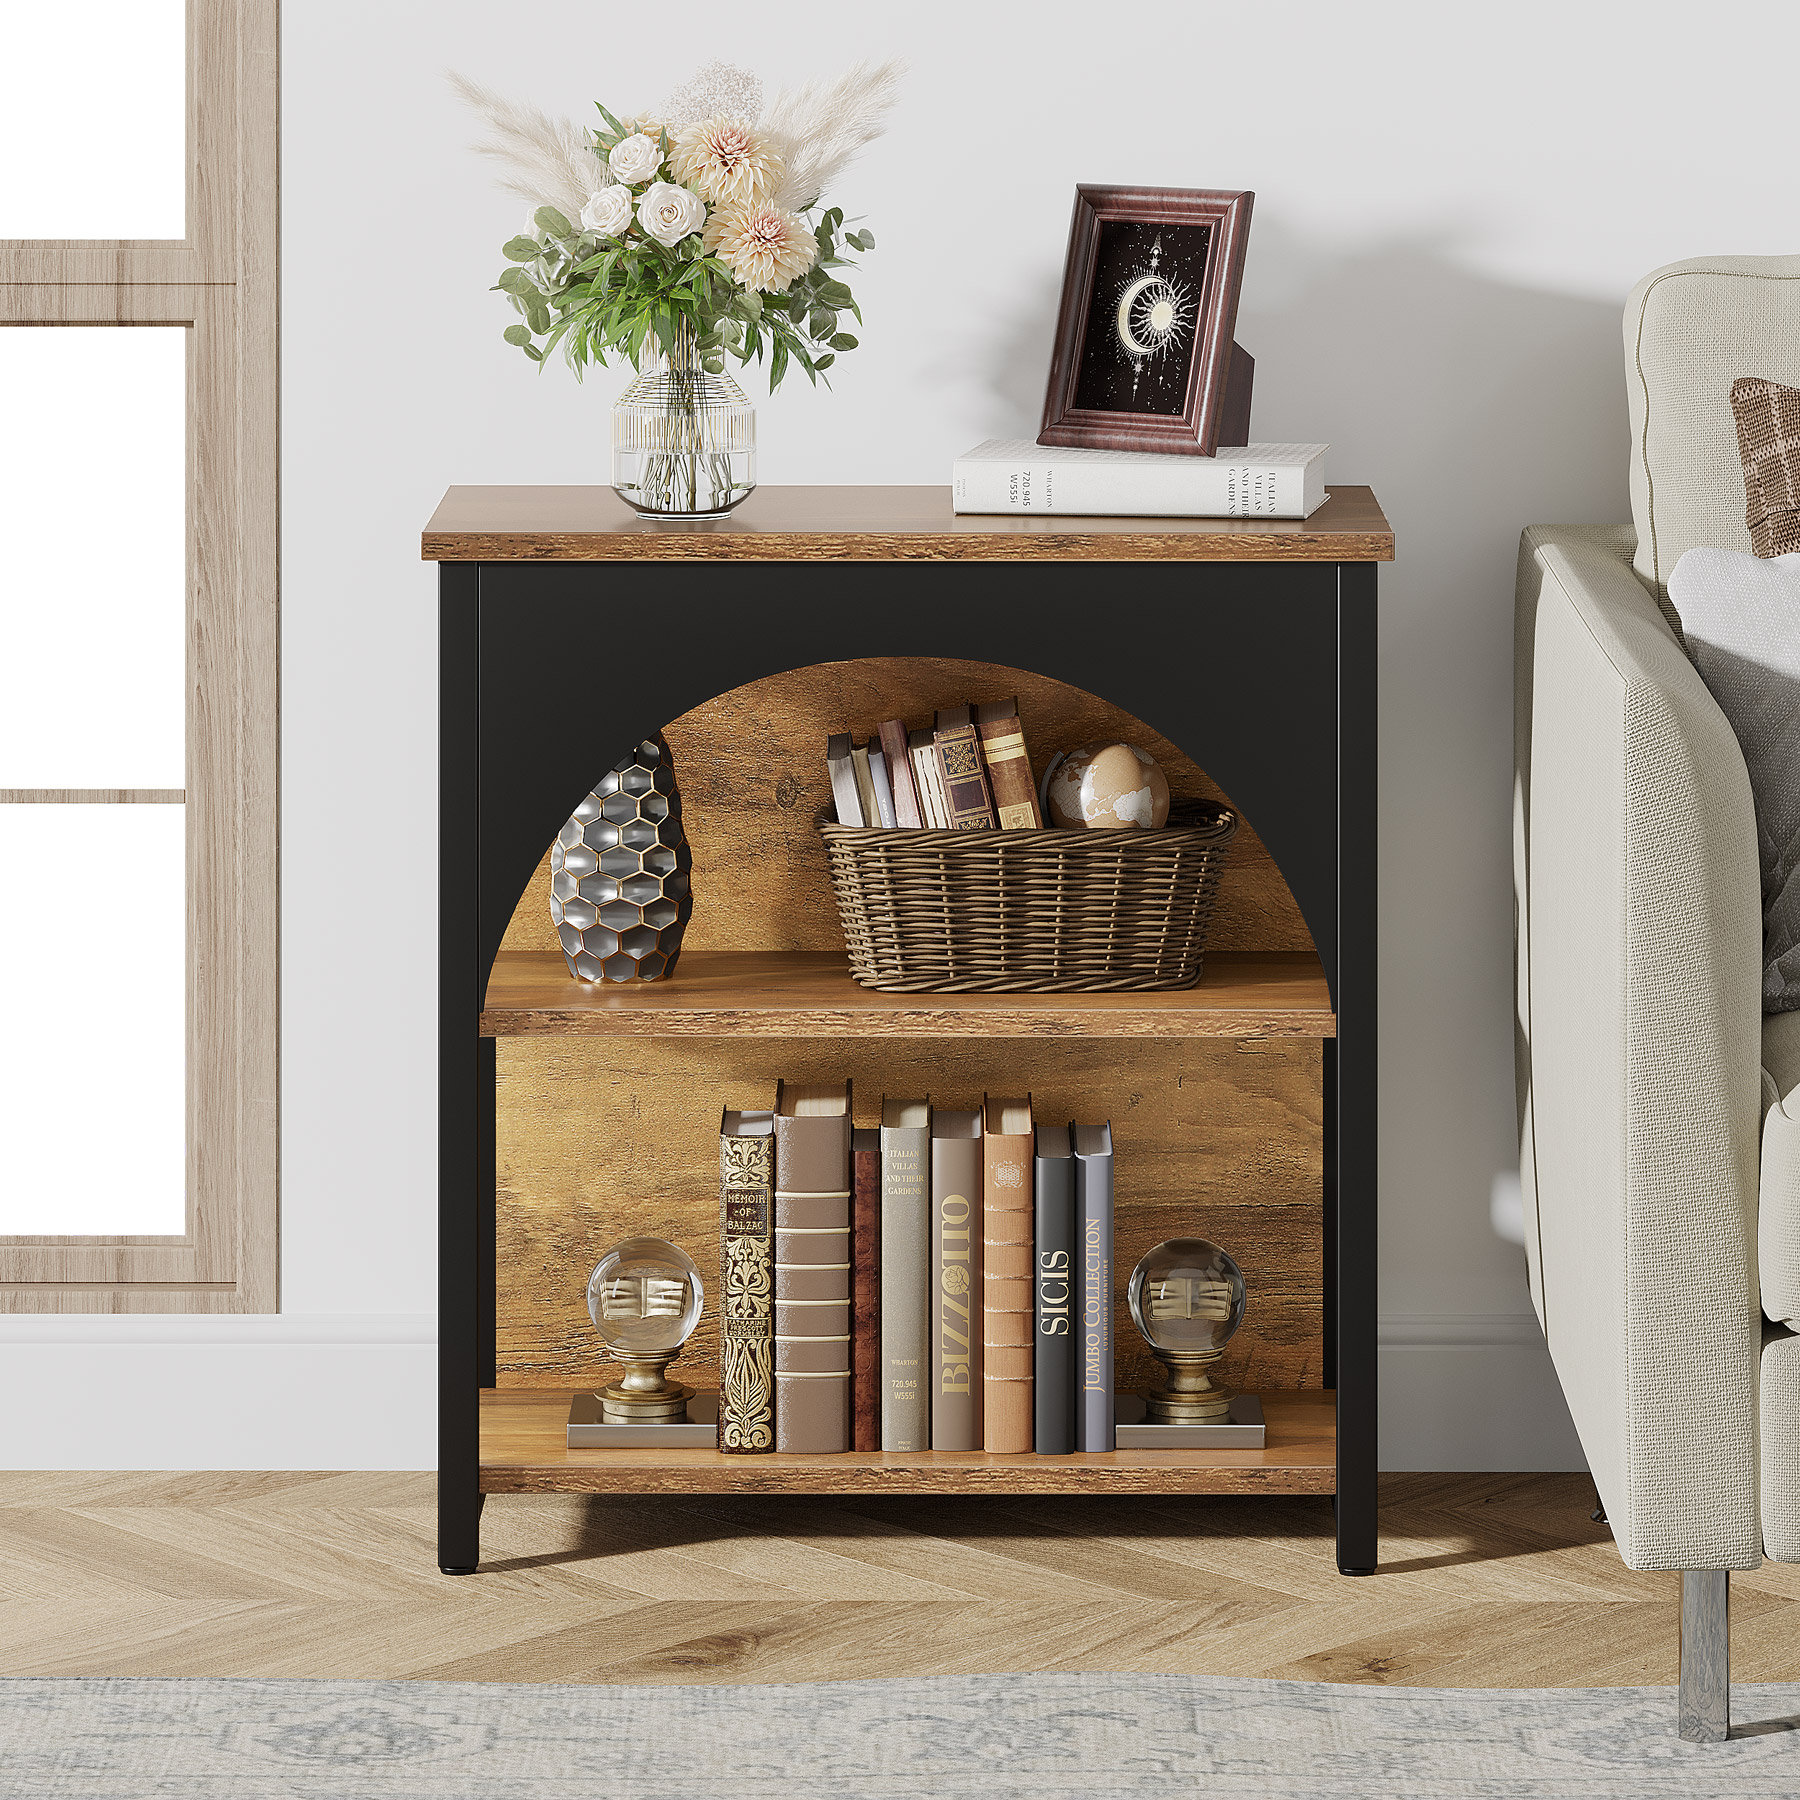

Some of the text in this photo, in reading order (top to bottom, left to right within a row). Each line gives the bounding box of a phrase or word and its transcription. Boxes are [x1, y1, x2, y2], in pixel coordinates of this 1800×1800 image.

[1010, 474, 1018, 503] W555i
[1022, 471, 1031, 507] 720.945
[1228, 468, 1236, 516] GARDENS
[1241, 466, 1249, 518] AND THEIR
[1255, 474, 1263, 512] VILLAS
[1268, 472, 1276, 514] ITALIAN
[889, 1149, 920, 1158] ITALIAN
[892, 1162, 918, 1170] VILLAS
[886, 1174, 924, 1183] AND THEIR
[888, 1186, 922, 1195] GARDENS
[727, 1194, 766, 1204] MEMOIR
[727, 1220, 764, 1230] BALZAC
[1040, 1249, 1069, 1337] SICIS
[1082, 1217, 1106, 1393] JUMBO COLLECTION
[891, 1379, 918, 1388] 720.945
